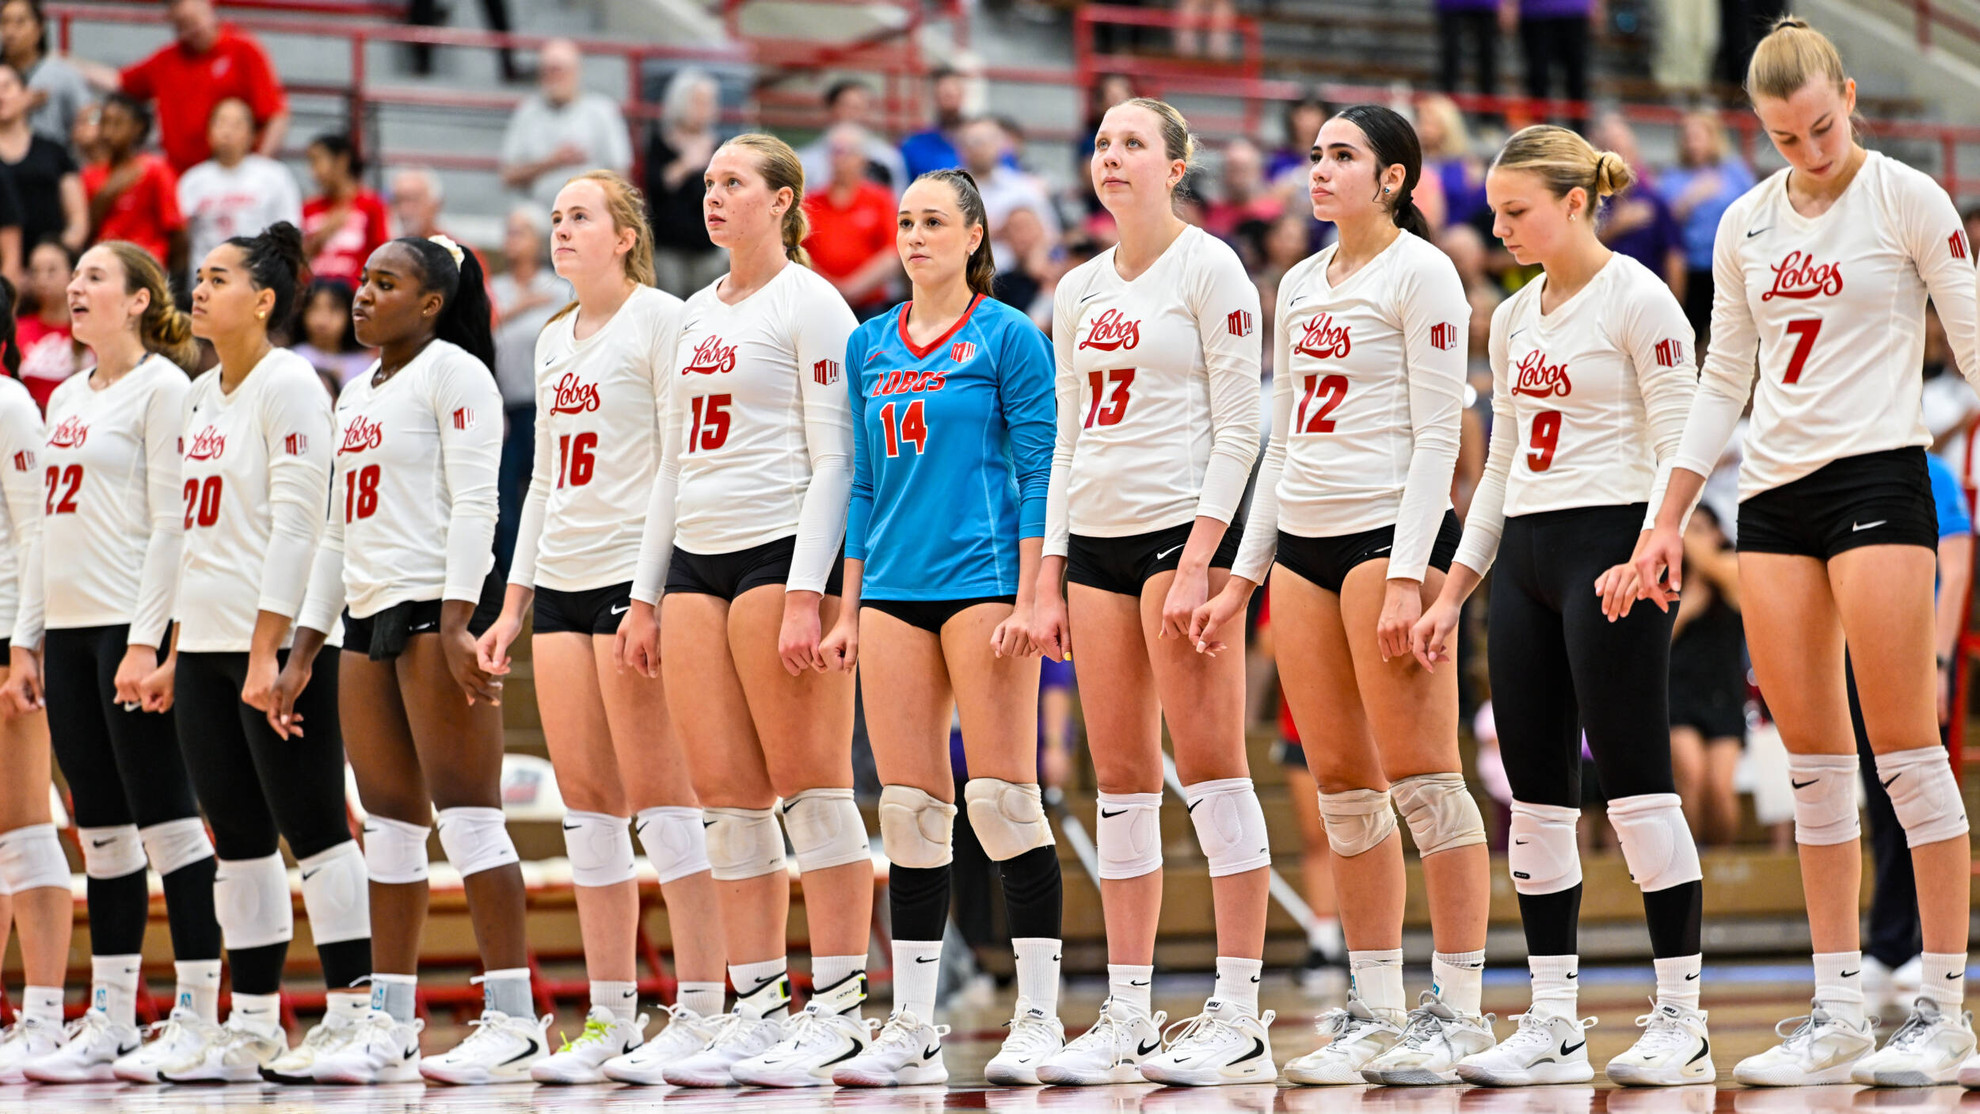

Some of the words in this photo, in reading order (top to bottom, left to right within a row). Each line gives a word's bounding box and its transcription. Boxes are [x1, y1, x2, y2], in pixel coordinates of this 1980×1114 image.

[1761, 250, 1844, 302] Lobos
[683, 334, 739, 376] Lobos
[1079, 308, 1141, 351] Lobos
[1294, 312, 1352, 360] Lobos
[1781, 318, 1823, 384] 7
[550, 372, 601, 416] Lobos
[871, 370, 951, 397] LOBOS
[1083, 367, 1136, 429] 13
[1511, 349, 1572, 398] Lobos
[688, 393, 732, 454] 15
[879, 399, 928, 458] 14
[1296, 374, 1348, 434] 12
[184, 425, 227, 461] Lobos
[337, 414, 383, 456] Lobos
[557, 432, 598, 489] 16
[1527, 410, 1562, 472] 9
[45, 463, 84, 516] 22
[184, 475, 223, 531] 20
[346, 464, 381, 524] 18
[1031, 1008, 1044, 1017] NIKE
[1662, 1006, 1677, 1015] NIKE
